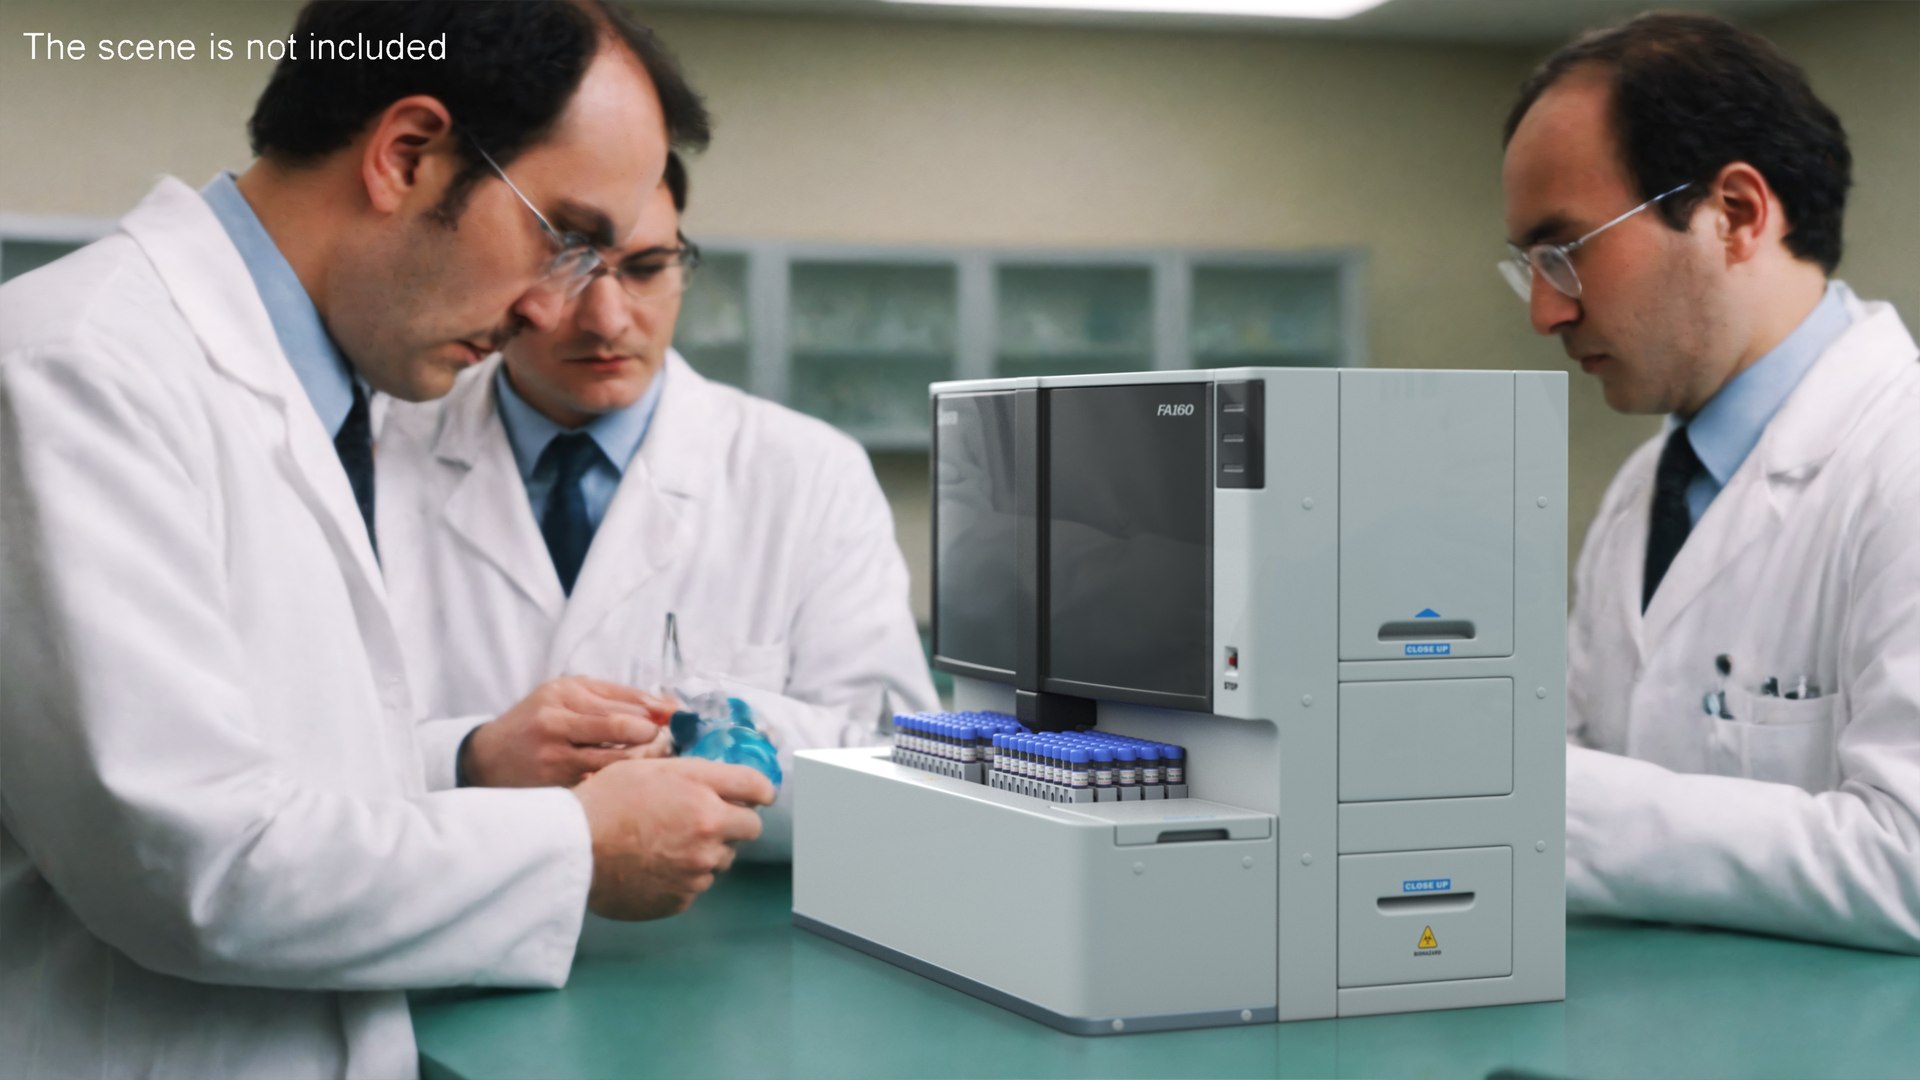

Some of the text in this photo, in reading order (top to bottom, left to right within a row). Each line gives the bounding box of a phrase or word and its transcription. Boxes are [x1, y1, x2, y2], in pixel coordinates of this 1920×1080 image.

[1157, 403, 1194, 416] FA160
[1406, 645, 1449, 654] CLOSE UP
[1223, 681, 1238, 691] STOP
[1405, 880, 1449, 890] CLOSE UP
